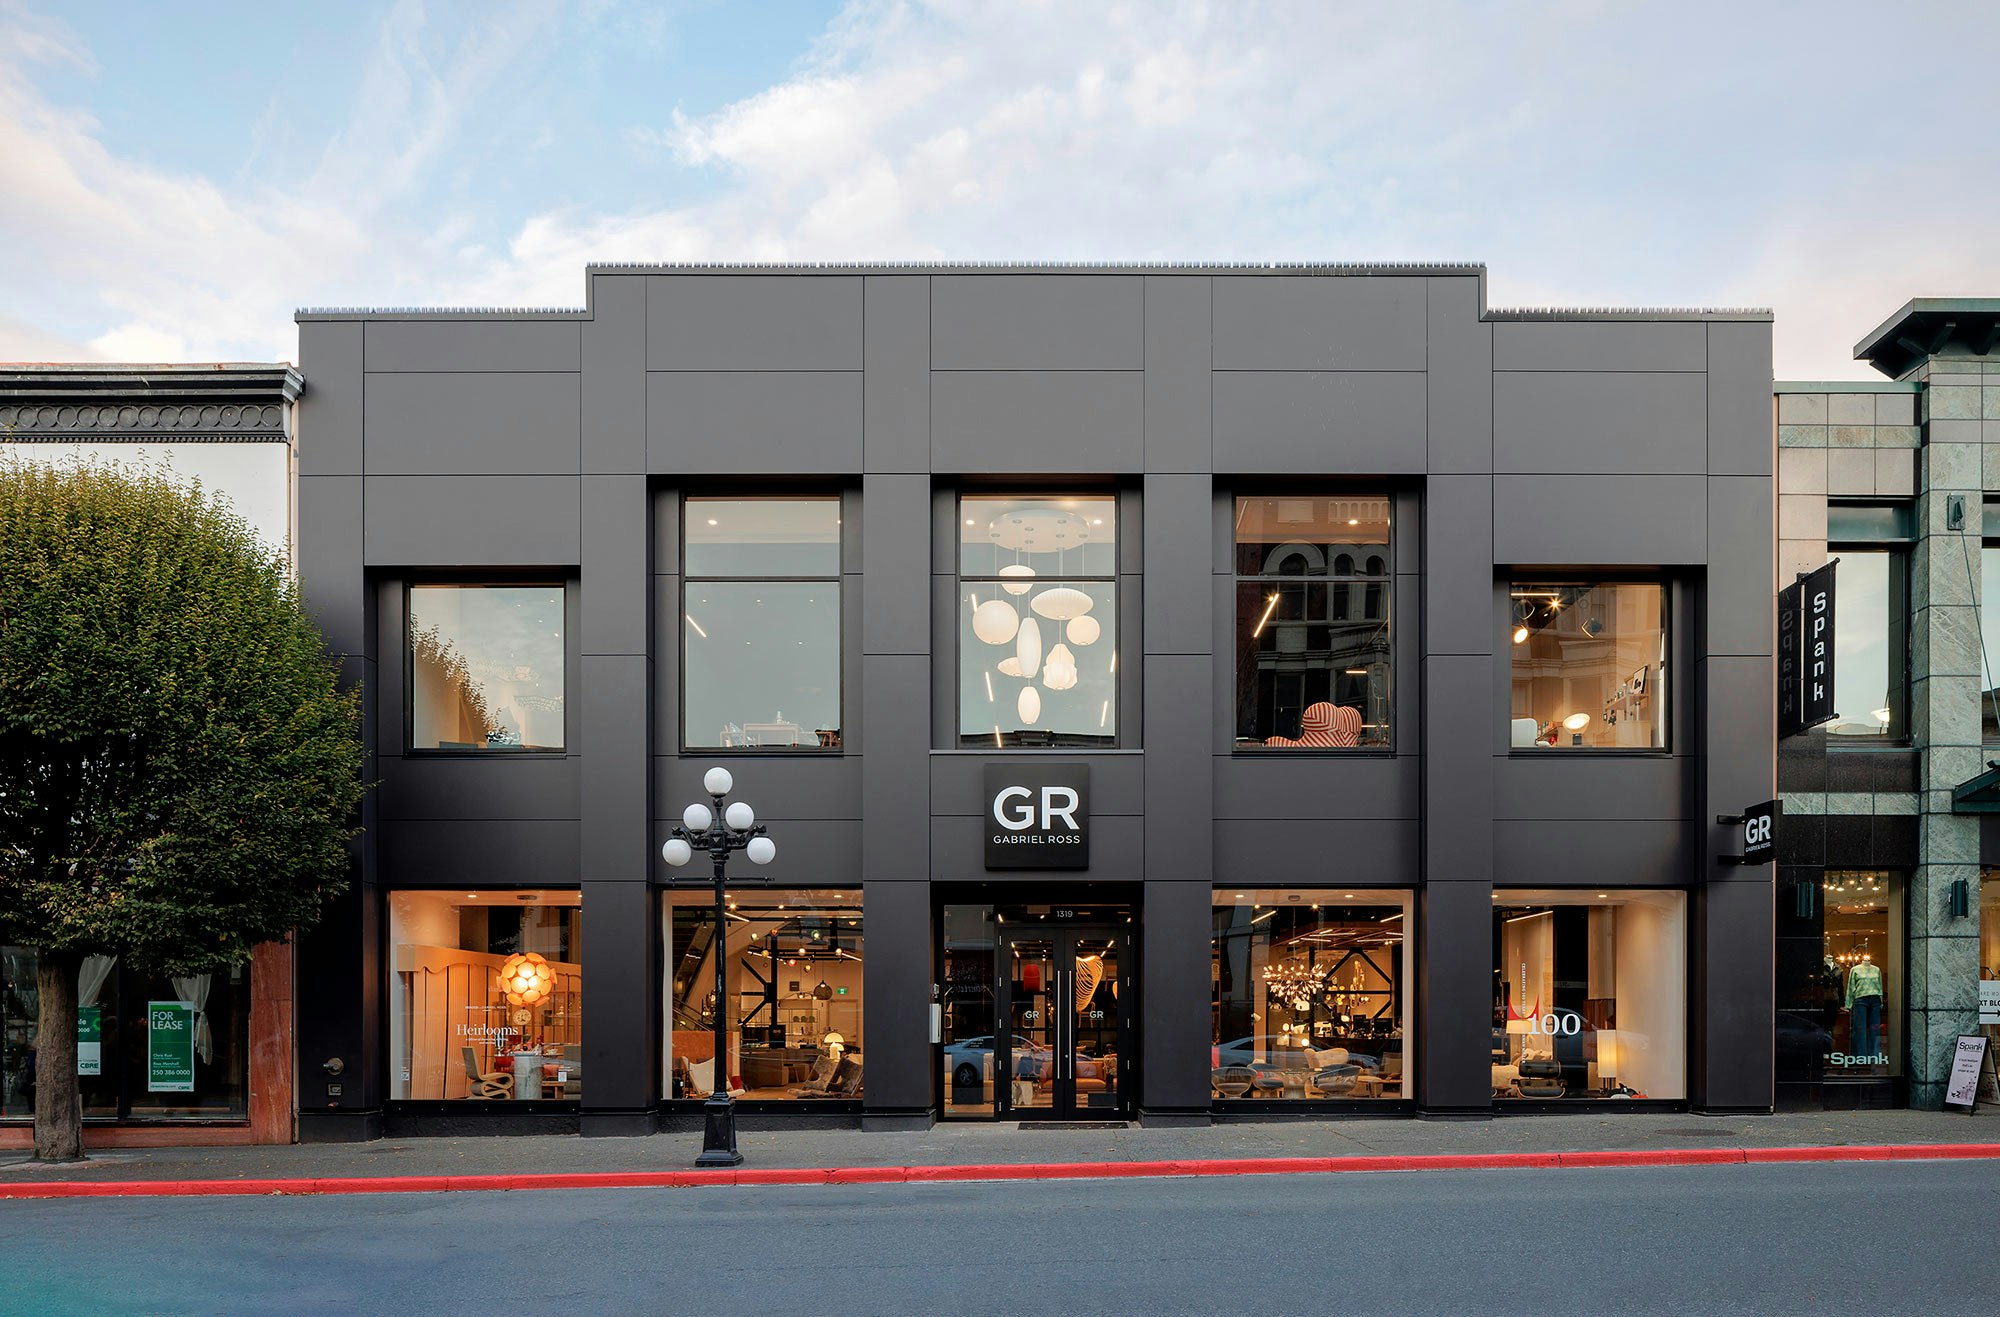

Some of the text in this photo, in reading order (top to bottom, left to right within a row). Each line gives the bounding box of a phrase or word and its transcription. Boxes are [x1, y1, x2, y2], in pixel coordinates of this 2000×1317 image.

[1813, 591, 1827, 702] Spank
[993, 785, 1080, 831] GR
[1745, 815, 1771, 844] GR
[993, 835, 1081, 844] GABRIEL ROSS
[1056, 910, 1073, 918] 1319
[152, 1011, 174, 1020] FOR
[1025, 1010, 1040, 1019] GR
[1089, 1010, 1104, 1019] GR
[152, 1020, 183, 1030] LEASE
[1528, 1013, 1580, 1035] 100
[457, 1023, 519, 1036] Heirlooms
[1959, 1041, 1983, 1051] Spank
[1830, 1052, 1889, 1068] Spank
